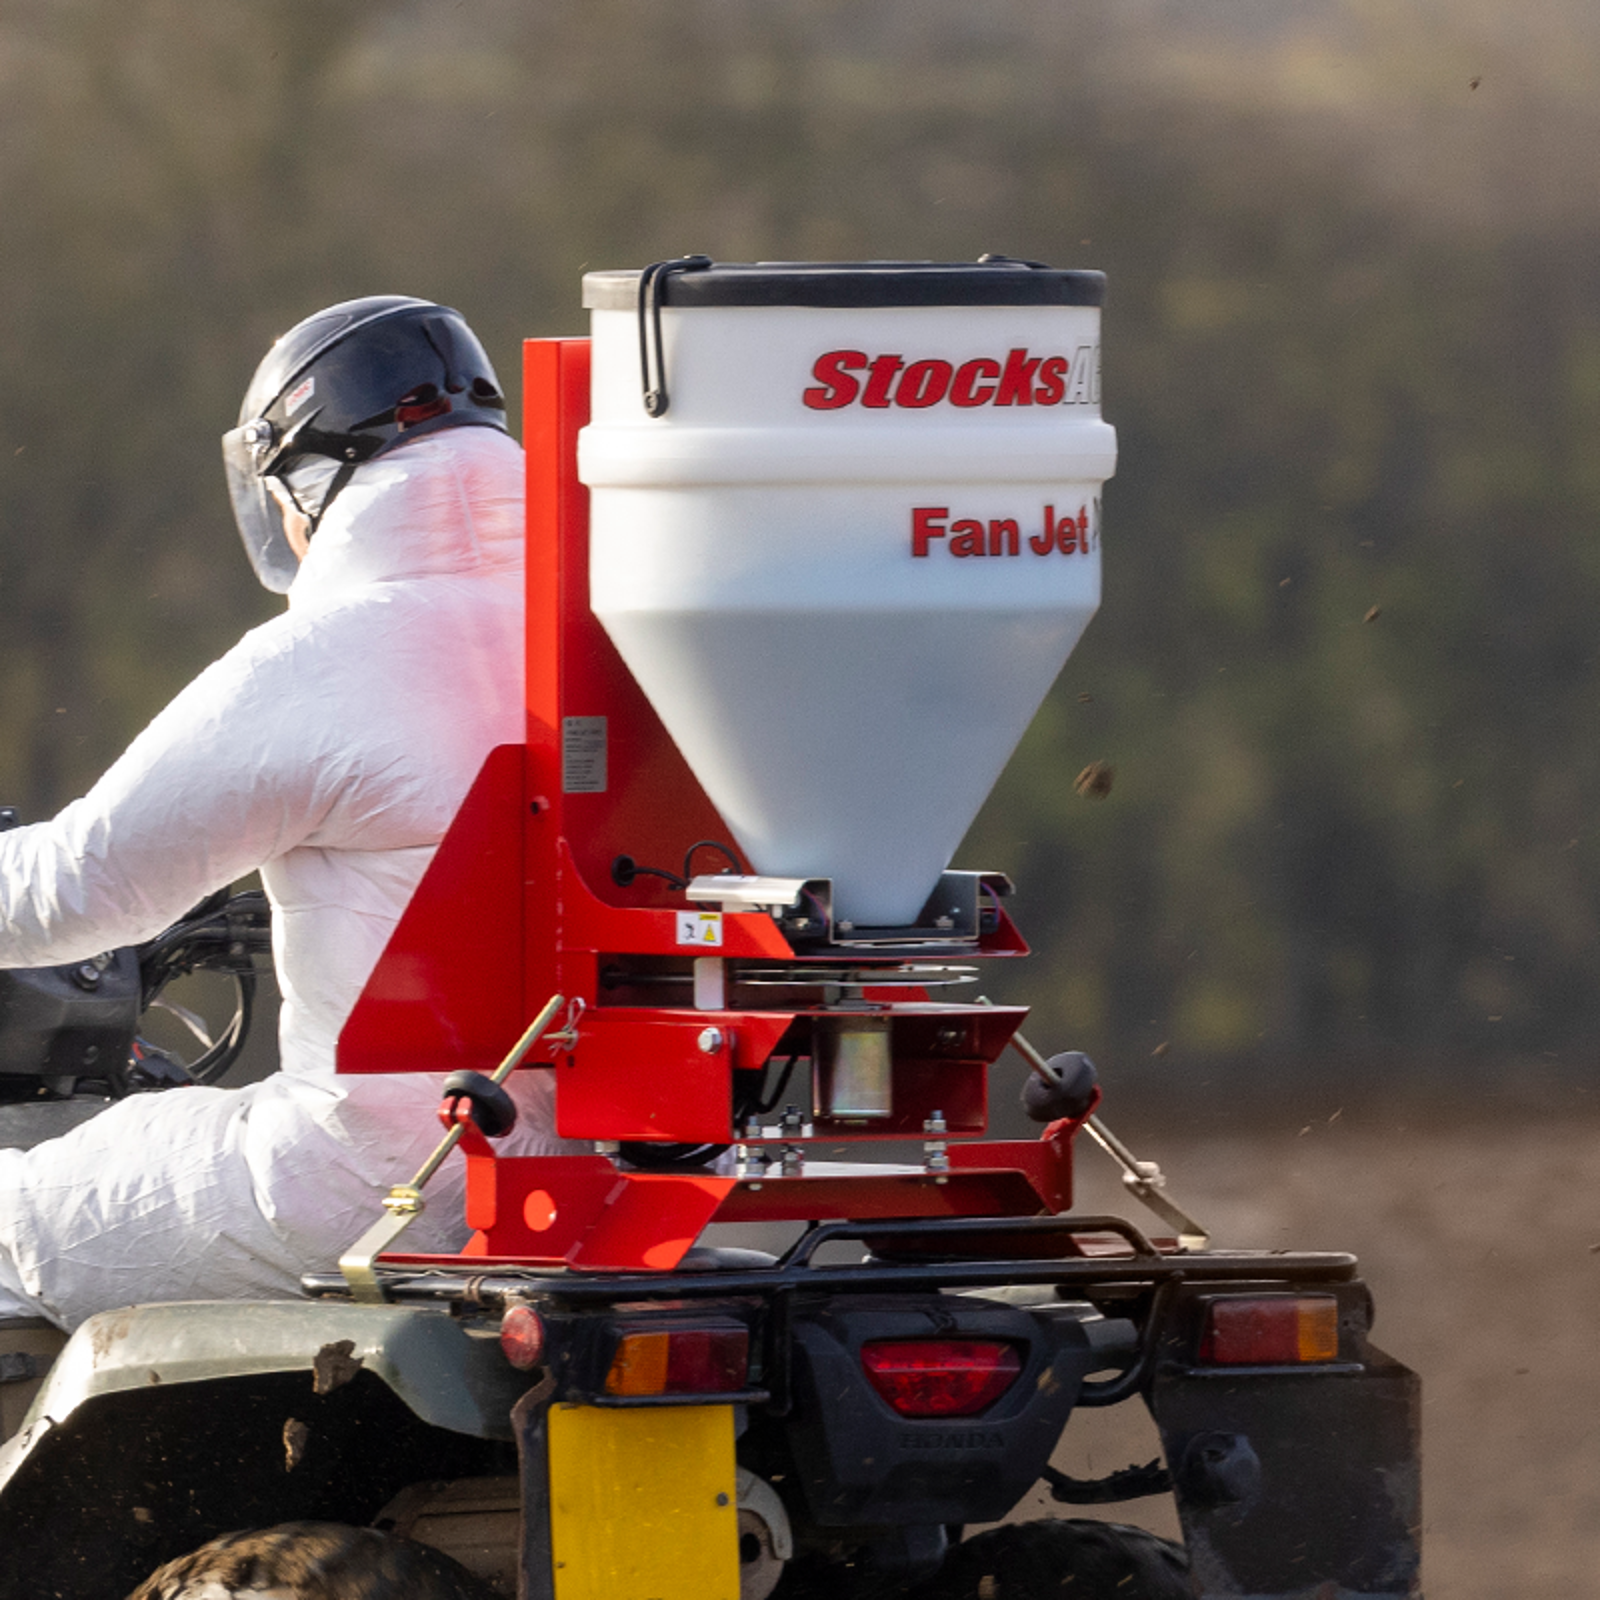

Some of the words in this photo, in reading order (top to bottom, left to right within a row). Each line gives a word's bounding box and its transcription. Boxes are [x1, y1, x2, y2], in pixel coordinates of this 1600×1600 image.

[911, 507, 1020, 557] Fan
[1029, 505, 1089, 556] Jet
[899, 1432, 1005, 1449] HONDA
